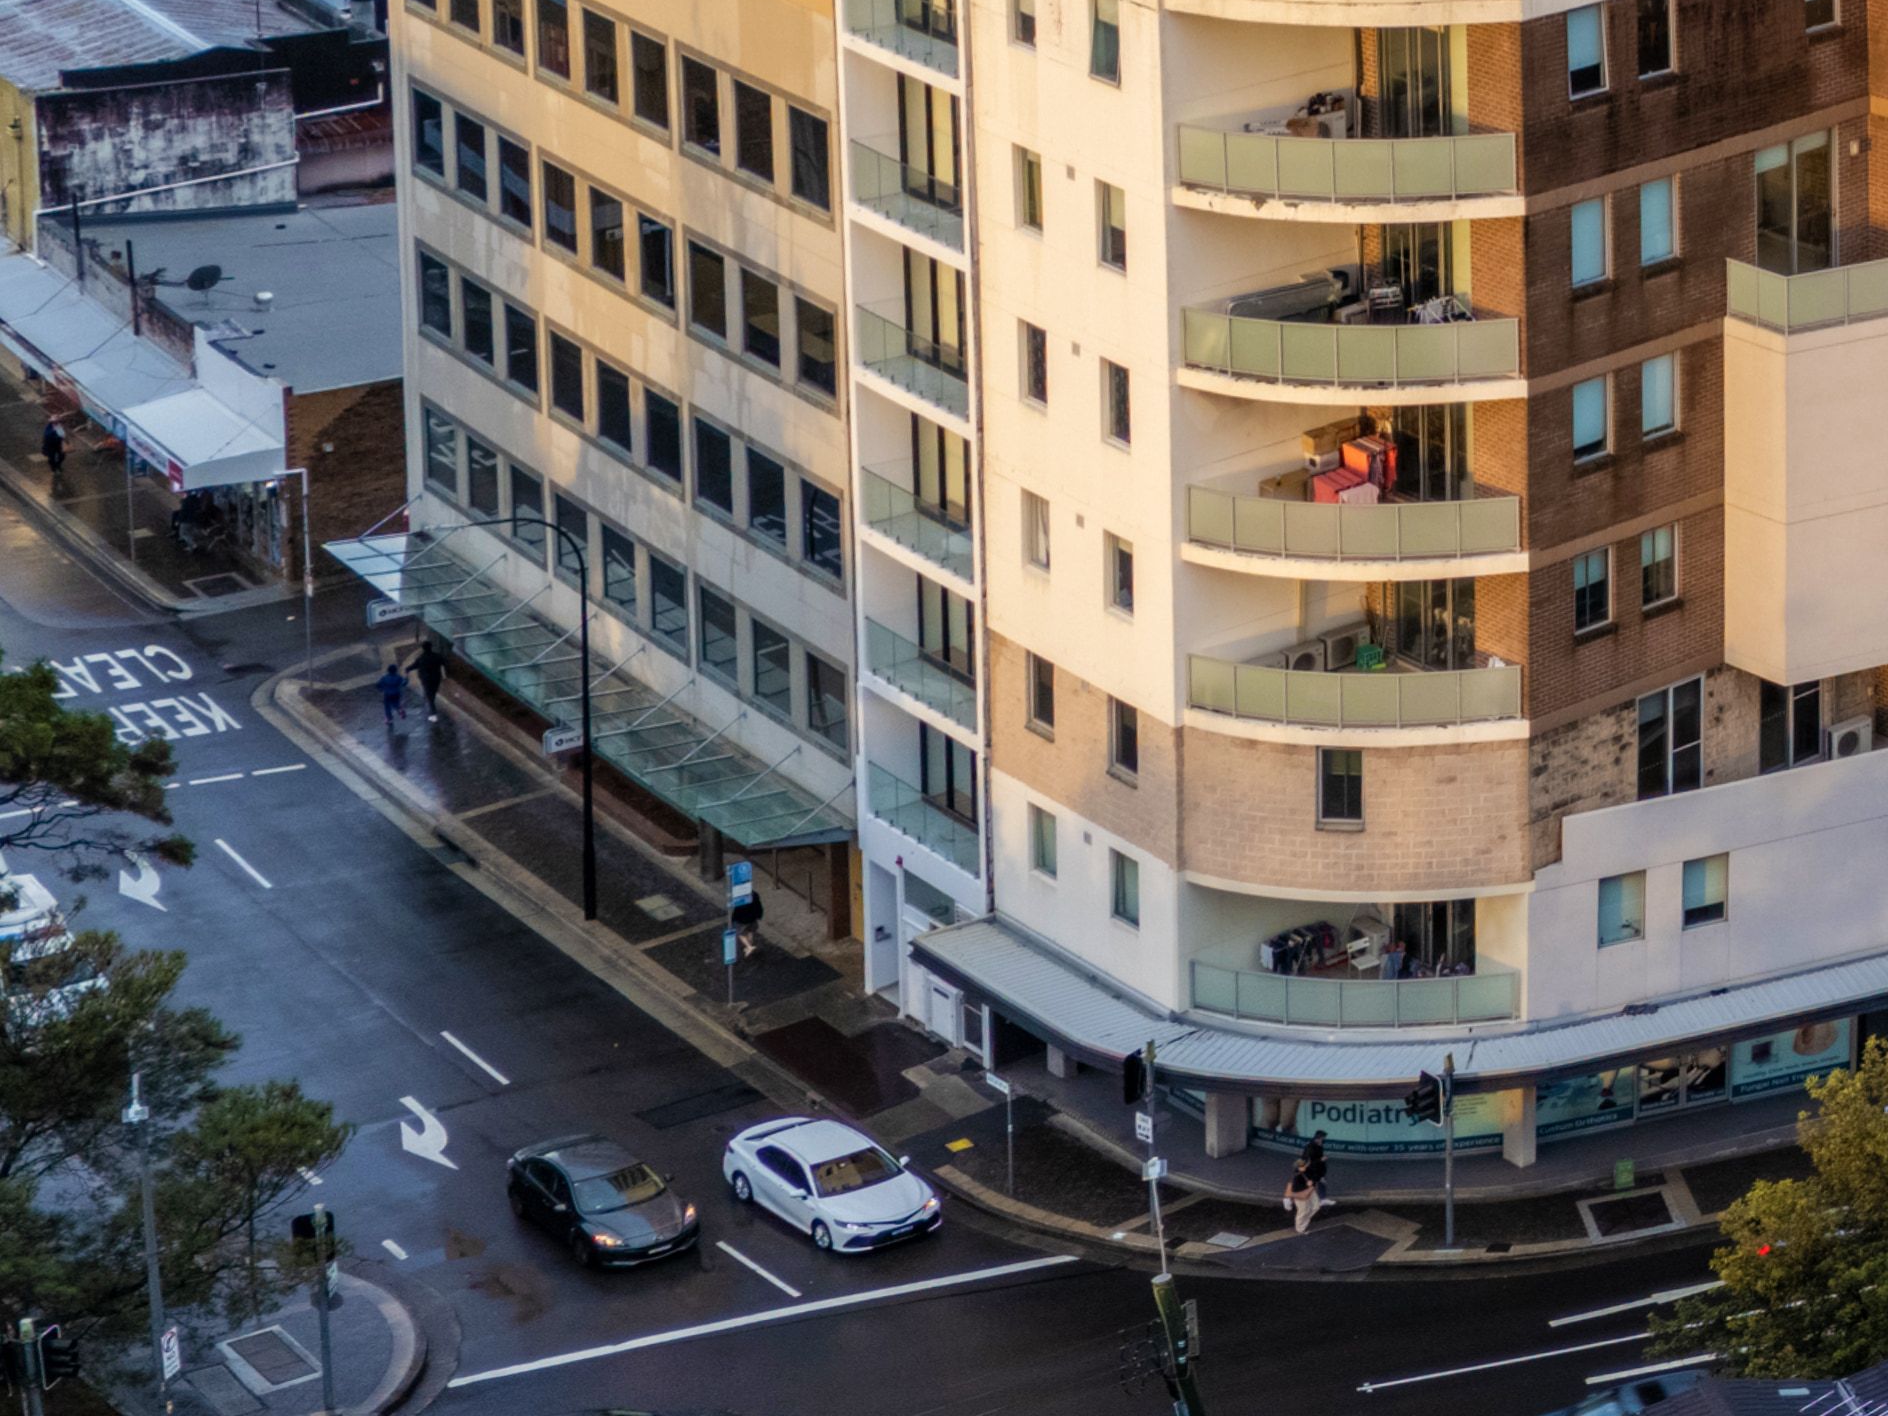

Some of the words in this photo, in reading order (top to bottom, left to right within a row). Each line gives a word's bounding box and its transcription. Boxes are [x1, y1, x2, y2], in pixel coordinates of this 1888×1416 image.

[107, 692, 243, 746] KEEP
[1408, 1143, 1434, 1153] years
[1454, 1136, 1501, 1150] xperience
